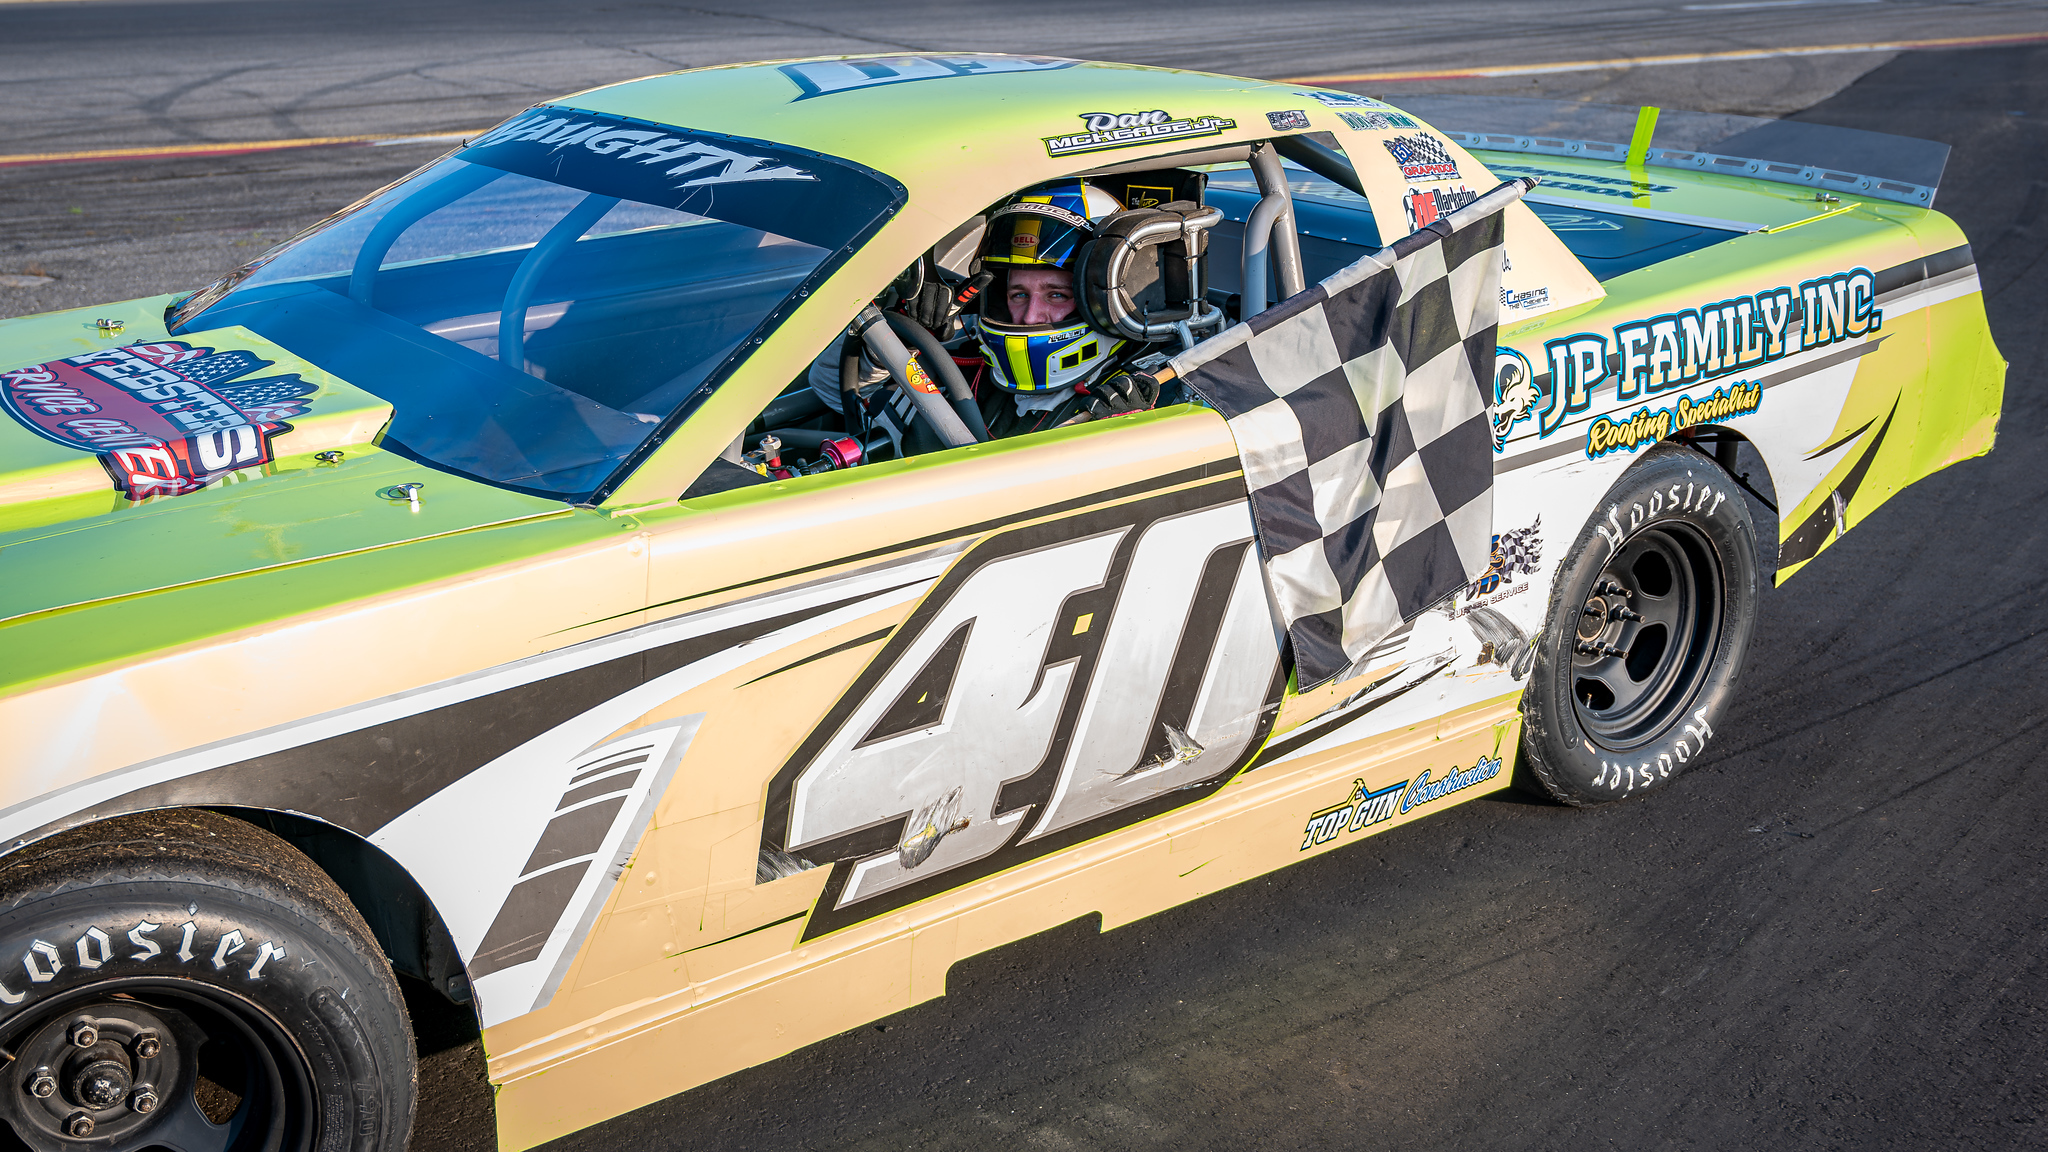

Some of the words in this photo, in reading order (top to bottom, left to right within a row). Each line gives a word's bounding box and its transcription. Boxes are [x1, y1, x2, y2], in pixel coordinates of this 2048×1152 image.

[1081, 110, 1169, 132] Dan
[1392, 144, 1412, 163] 151
[1403, 163, 1456, 176] GRAPHIXX
[1013, 235, 1035, 244] BELL
[1541, 335, 1608, 436] JP
[1614, 288, 1791, 400] FAMILY
[1798, 267, 1883, 351] INC.
[1587, 408, 1670, 457] Roofing
[1676, 380, 1762, 429] Specialist
[1598, 470, 1727, 563] Hoosier
[1489, 582, 1529, 605] SERVICE
[782, 498, 1287, 914] 40
[1591, 704, 1714, 798] Hoosier
[1300, 805, 1353, 851] TOP
[1350, 787, 1406, 833] GUN
[1400, 756, 1502, 815] Construction
[0, 900, 288, 1006] oosier
